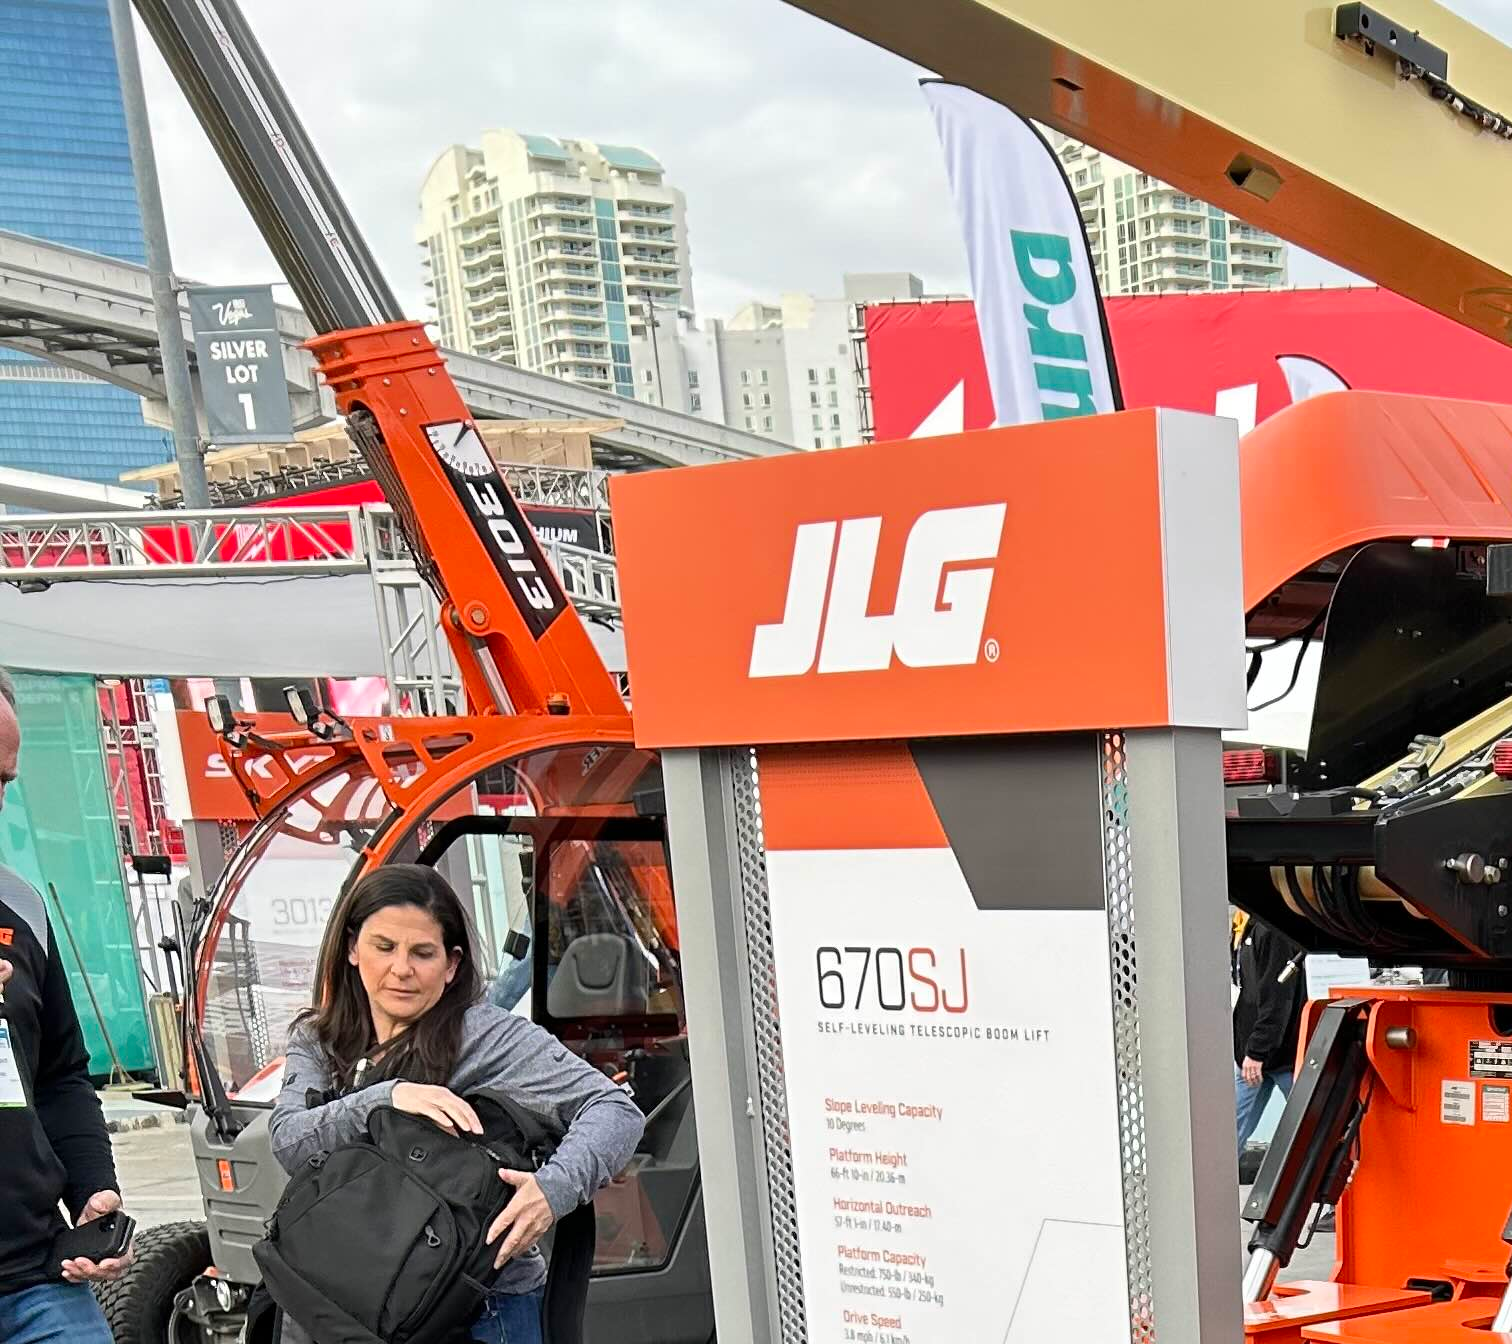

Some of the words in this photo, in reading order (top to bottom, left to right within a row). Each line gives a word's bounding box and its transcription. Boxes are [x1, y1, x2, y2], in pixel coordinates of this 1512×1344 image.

[209, 340, 268, 361] SILVER
[226, 364, 258, 384] LOT
[238, 392, 256, 430] 1
[531, 526, 578, 543] HIUM
[466, 481, 554, 610] 3013
[748, 502, 1008, 678] JLG
[816, 946, 969, 1014] 670SJ
[817, 1021, 905, 1037] SELF-LEVELING
[910, 1024, 981, 1040] TELESCOPIC
[986, 1028, 1019, 1041] BOOM
[1024, 1030, 1051, 1042] LIFT
[825, 1098, 852, 1114] Slope
[855, 1100, 896, 1118] Leveling
[899, 1103, 943, 1121] Capacity
[836, 1117, 866, 1133] Degrees
[829, 1147, 873, 1164] Platform
[875, 1152, 908, 1168] Height
[833, 1197, 883, 1213] Horizontal
[885, 1201, 932, 1218] Outreach
[837, 1245, 881, 1261] Platform
[883, 1250, 927, 1269] Capacity
[843, 1310, 869, 1325] Drive
[870, 1313, 902, 1329] Speed
